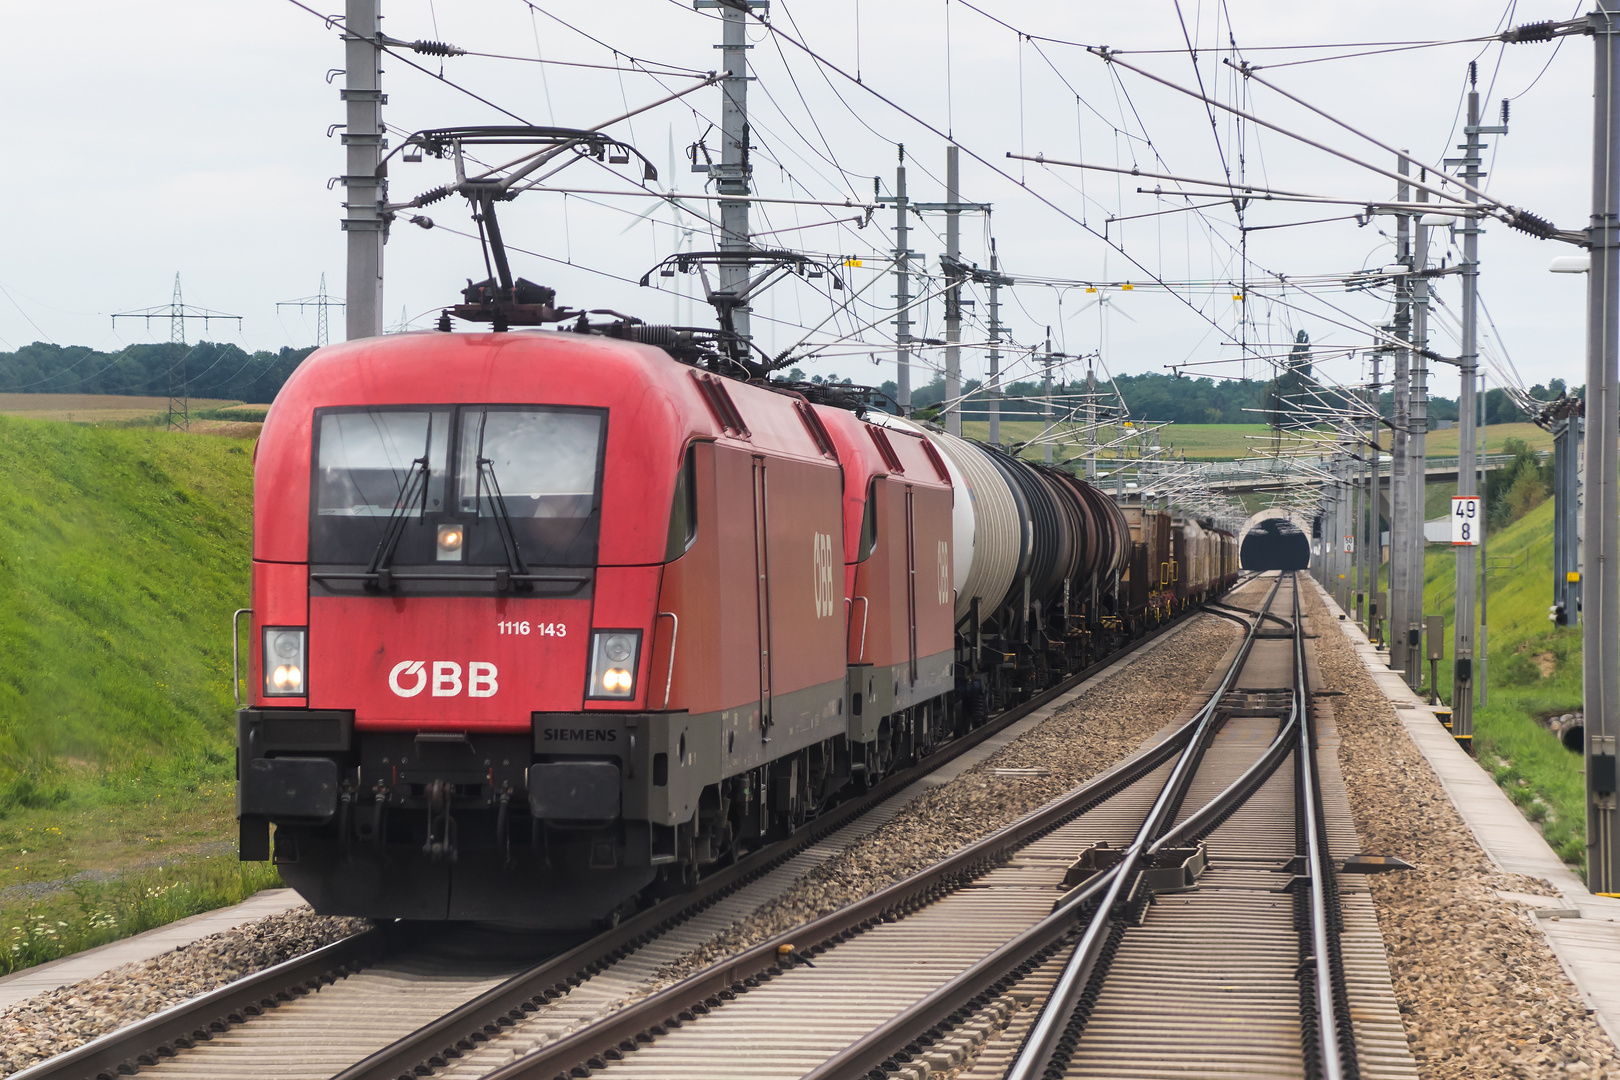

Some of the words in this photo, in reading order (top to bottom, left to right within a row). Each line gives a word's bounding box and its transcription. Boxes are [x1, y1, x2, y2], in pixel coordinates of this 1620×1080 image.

[1456, 501, 1475, 518] 49
[1461, 522, 1470, 540] 8
[813, 531, 834, 619] ÖBB
[497, 621, 531, 635] 1116
[537, 623, 567, 637] 143
[388, 660, 499, 698] ÖBB
[543, 728, 617, 741] SIEMENS
